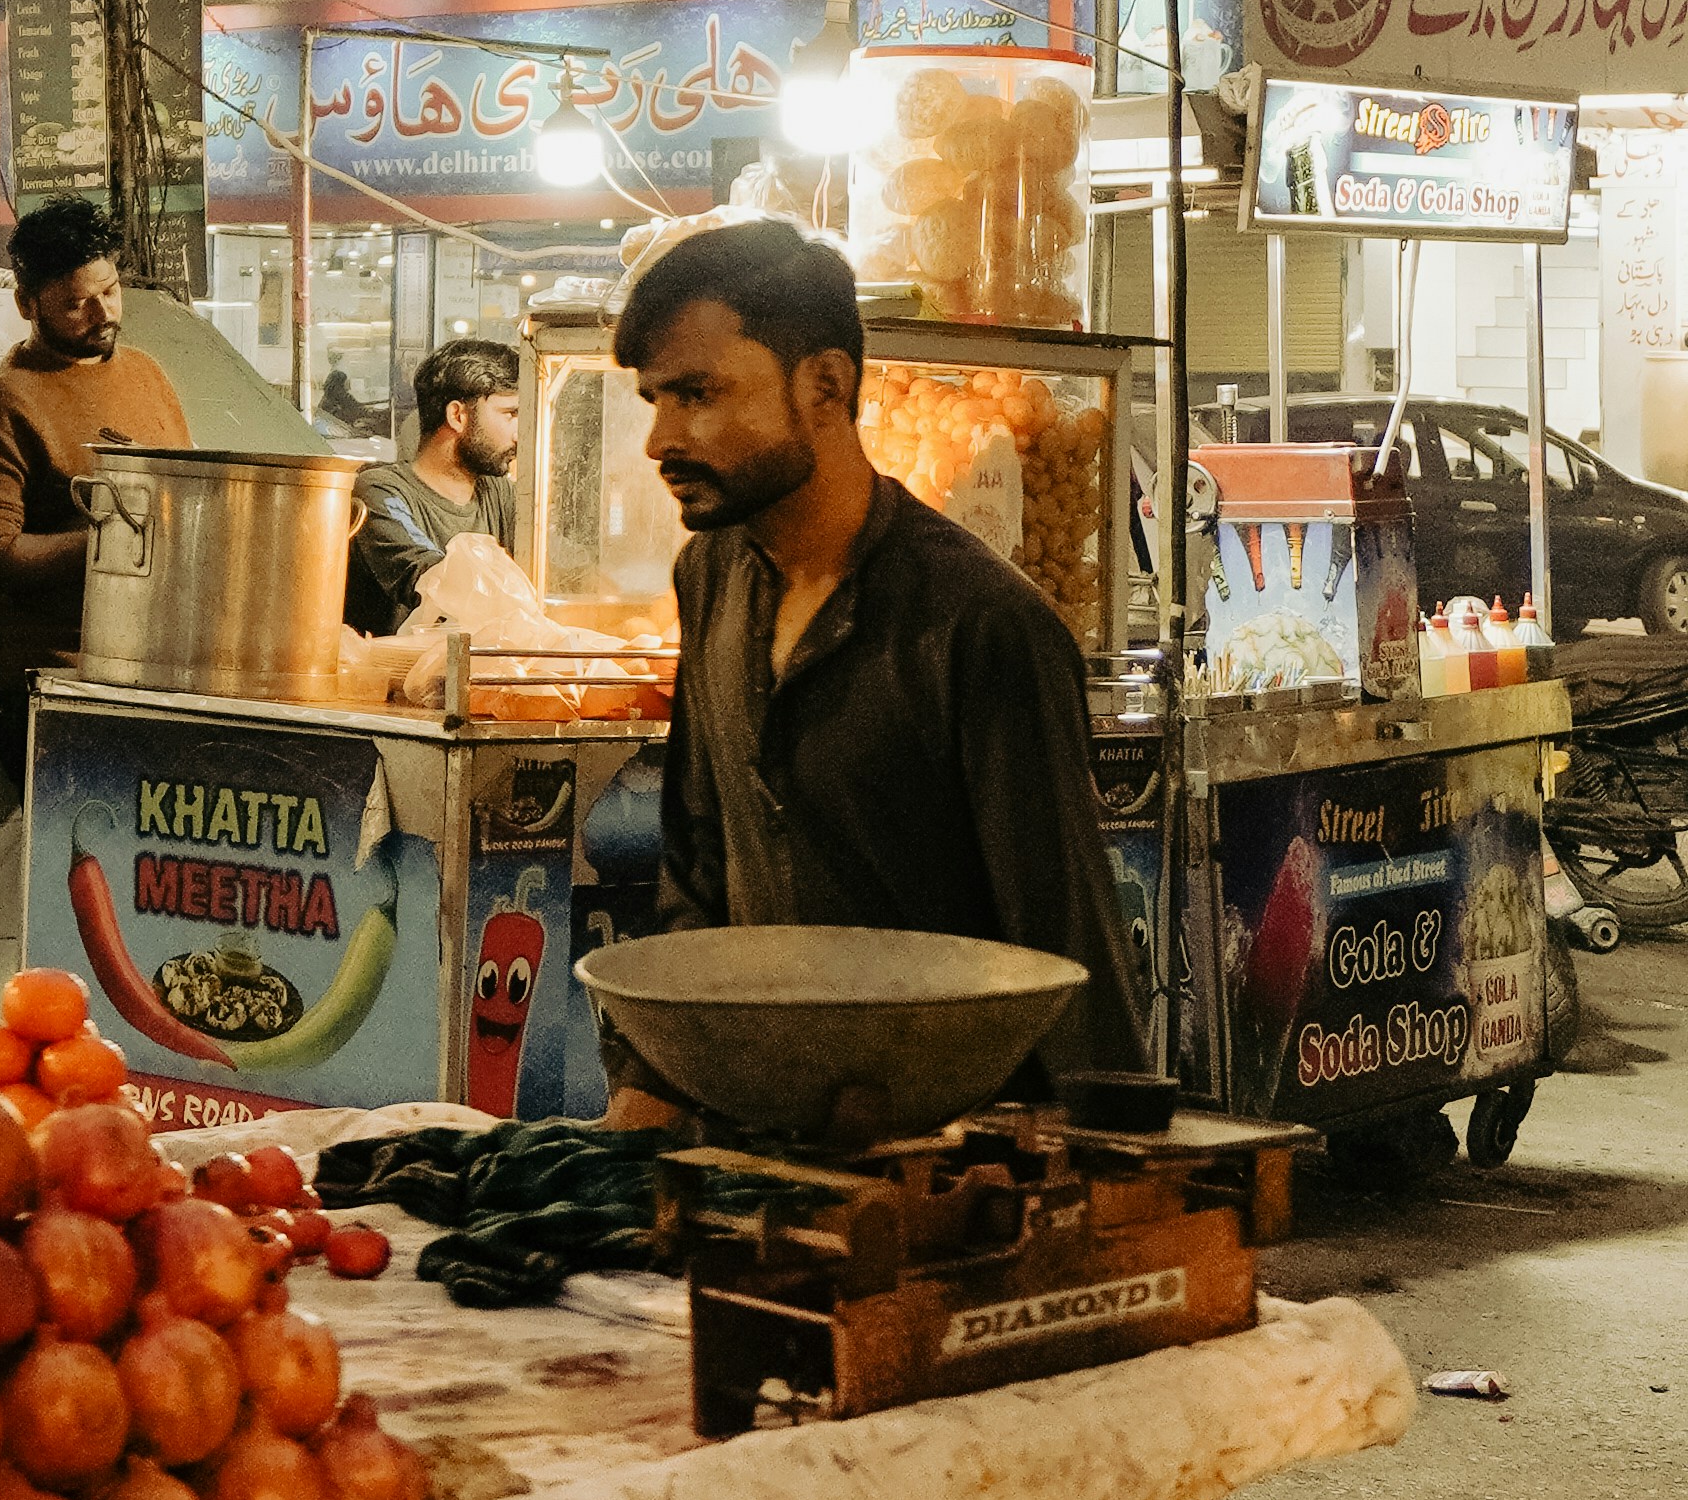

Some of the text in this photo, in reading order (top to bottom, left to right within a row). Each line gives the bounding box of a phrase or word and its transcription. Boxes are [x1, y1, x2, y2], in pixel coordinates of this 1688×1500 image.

[206, 111, 233, 137] فالود
[1354, 96, 1421, 144] Street
[352, 147, 713, 178] www.delhirabouse.co
[1335, 172, 1521, 225] Soda & Gola Shop
[1618, 256, 1665, 288] پاکستانی
[1615, 291, 1668, 321] دل بہار
[1099, 747, 1144, 761] KHATTA
[138, 779, 328, 854] KHATTA
[1317, 799, 1385, 843] Street
[136, 853, 339, 938] MEETHA
[1329, 870, 1370, 896] Famous
[1372, 865, 1386, 887] of
[1412, 858, 1447, 881] Street
[1330, 909, 1441, 989] Gola &
[1486, 973, 1518, 1007] GOLA
[1298, 1001, 1467, 1087] Soda Shop
[1481, 1014, 1522, 1051] GANDA
[183, 1093, 256, 1129] ROAD
[961, 1282, 1151, 1342] DIAMOND
